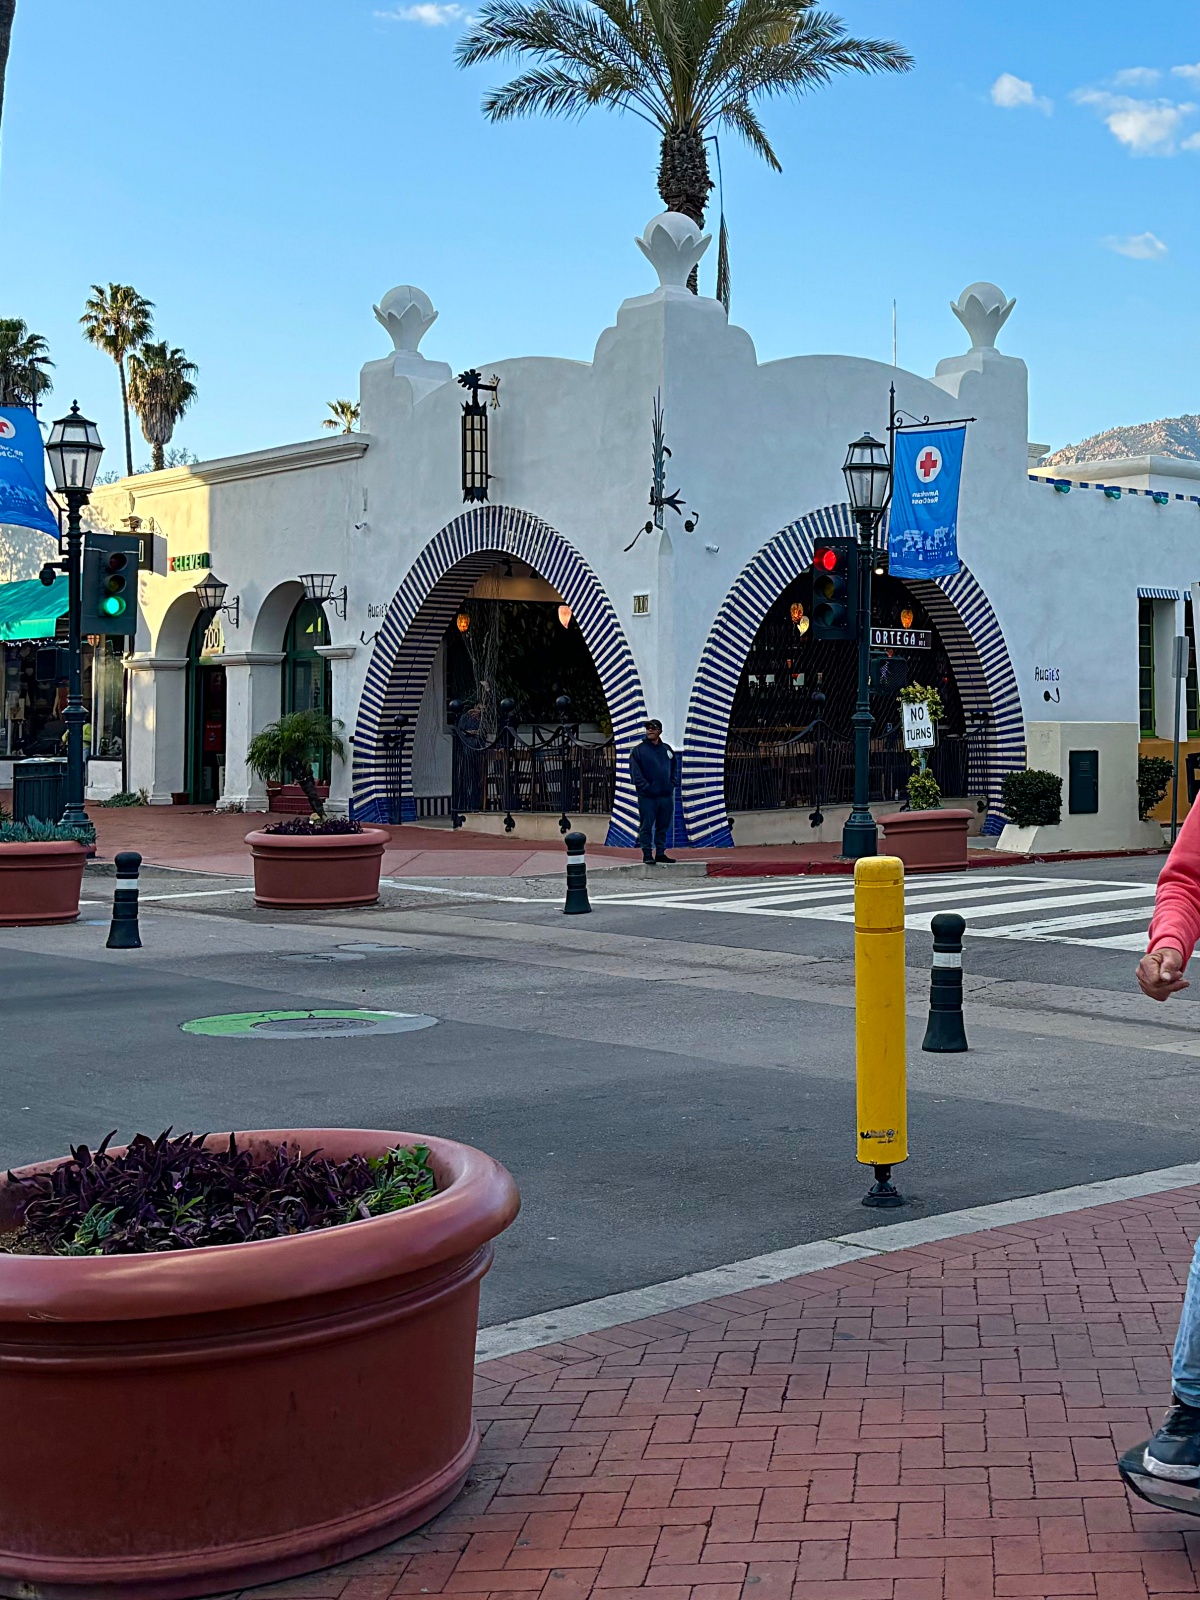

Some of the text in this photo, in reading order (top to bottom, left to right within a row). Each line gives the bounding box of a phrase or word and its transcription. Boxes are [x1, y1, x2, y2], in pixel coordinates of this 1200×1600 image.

[204, 628, 219, 649] 700
[875, 630, 916, 646] ORTEGA
[911, 707, 924, 721] NO
[906, 727, 932, 741] TURNS
